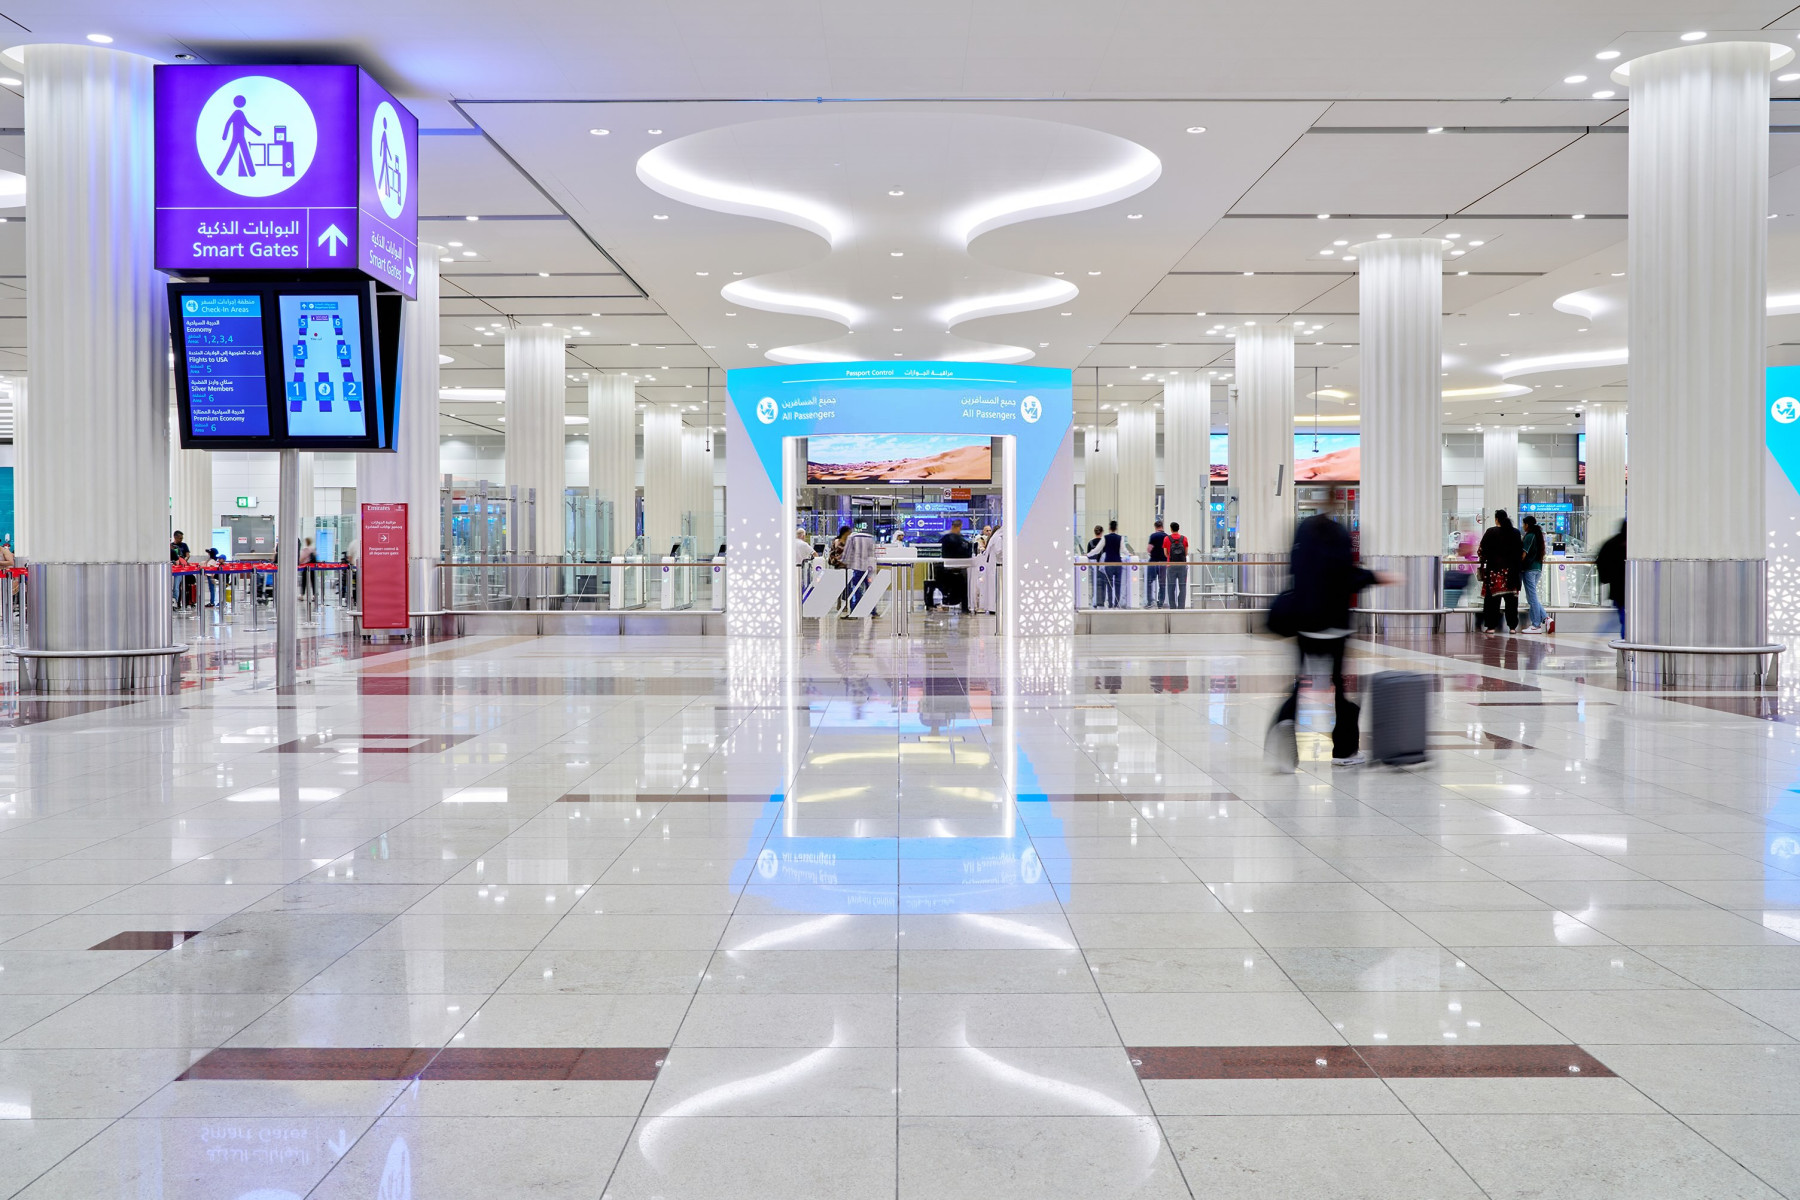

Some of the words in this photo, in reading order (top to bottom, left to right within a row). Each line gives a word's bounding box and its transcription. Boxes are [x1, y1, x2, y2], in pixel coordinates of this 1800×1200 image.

[197, 220, 239, 238] الذكية
[243, 220, 299, 238] البوابات
[193, 242, 244, 257] Smart
[249, 242, 299, 257] Gates
[370, 250, 386, 272] Smart
[386, 260, 402, 281] Gates
[297, 345, 304, 355] 3
[340, 345, 348, 355] 4
[206, 365, 212, 373] 5
[294, 382, 299, 396] 1
[348, 382, 357, 396] 2
[782, 396, 817, 408] المسافرين
[819, 397, 836, 408] جميع
[961, 395, 999, 405] المسافرين
[1000, 399, 1016, 408] جميع
[782, 412, 792, 420] All
[794, 411, 835, 420] Passengers
[962, 410, 974, 418] All
[976, 410, 1016, 421] Passengers
